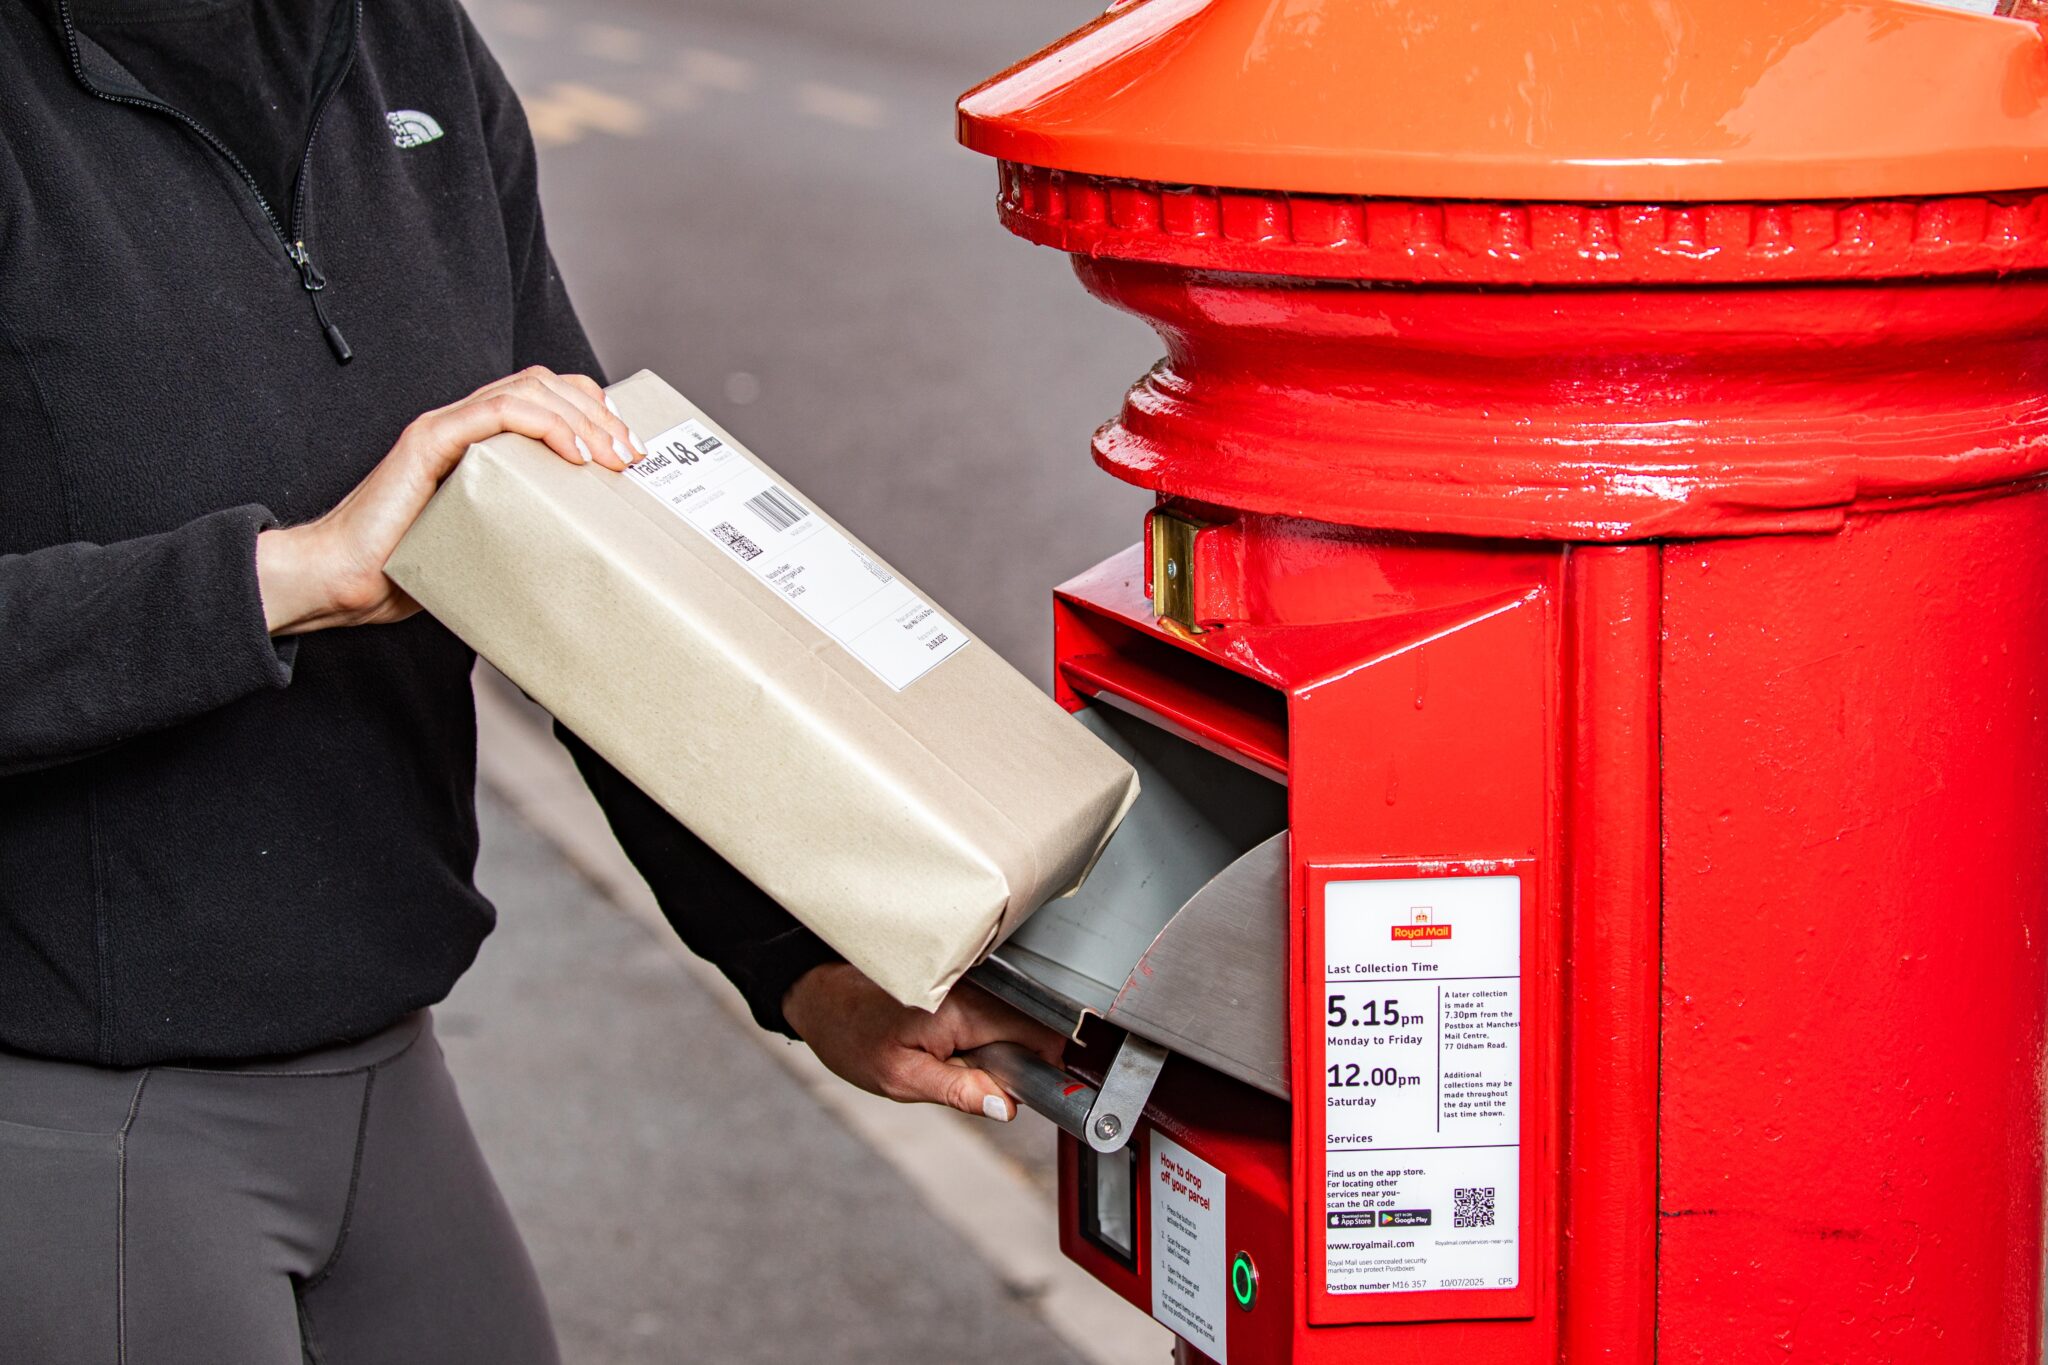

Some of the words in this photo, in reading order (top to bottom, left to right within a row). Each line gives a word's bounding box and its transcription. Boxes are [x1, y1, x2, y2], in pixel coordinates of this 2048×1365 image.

[696, 440, 710, 452] Royal
[709, 438, 720, 448] Mail
[628, 452, 672, 478] Tracked
[666, 442, 700, 466] 48
[1394, 927, 1424, 939] Royal
[1426, 926, 1448, 937] Mail
[1328, 964, 1350, 974] Last
[1354, 964, 1408, 974] Collection
[1412, 962, 1438, 972] Time
[1328, 994, 1424, 1028] 5.15pm
[1444, 1010, 1478, 1020] 7.30pm
[1328, 1036, 1370, 1048] Monday
[1374, 1036, 1384, 1044] to
[1388, 1034, 1422, 1046] Friday
[1328, 1064, 1420, 1088] 12.00pm
[1466, 1090, 1508, 1098] throughout
[1328, 1096, 1376, 1108] Saturday
[1328, 1134, 1372, 1144] Services
[1160, 1152, 1176, 1172] How
[1176, 1162, 1184, 1178] to
[1185, 1168, 1202, 1191] drop
[1326, 1170, 1344, 1178] Find
[1370, 1168, 1384, 1176] the
[1342, 1180, 1374, 1188] locating
[1376, 1178, 1398, 1186] other
[1160, 1170, 1170, 1186] off
[1172, 1178, 1188, 1196] your
[1188, 1188, 1210, 1211] parcel
[1326, 1190, 1358, 1198] services
[1362, 1200, 1374, 1208] QR
[1326, 1240, 1414, 1250] www.royalmail.com
[1328, 1260, 1344, 1268] Royal
[1374, 1258, 1402, 1266] concealed
[1326, 1284, 1358, 1292] Postbox
[1360, 1282, 1390, 1291] number
[1392, 1280, 1408, 1290] M16
[1412, 1280, 1426, 1288] 357
[1440, 1278, 1484, 1288] 10/07/2025
[1498, 1278, 1514, 1286] CP5
